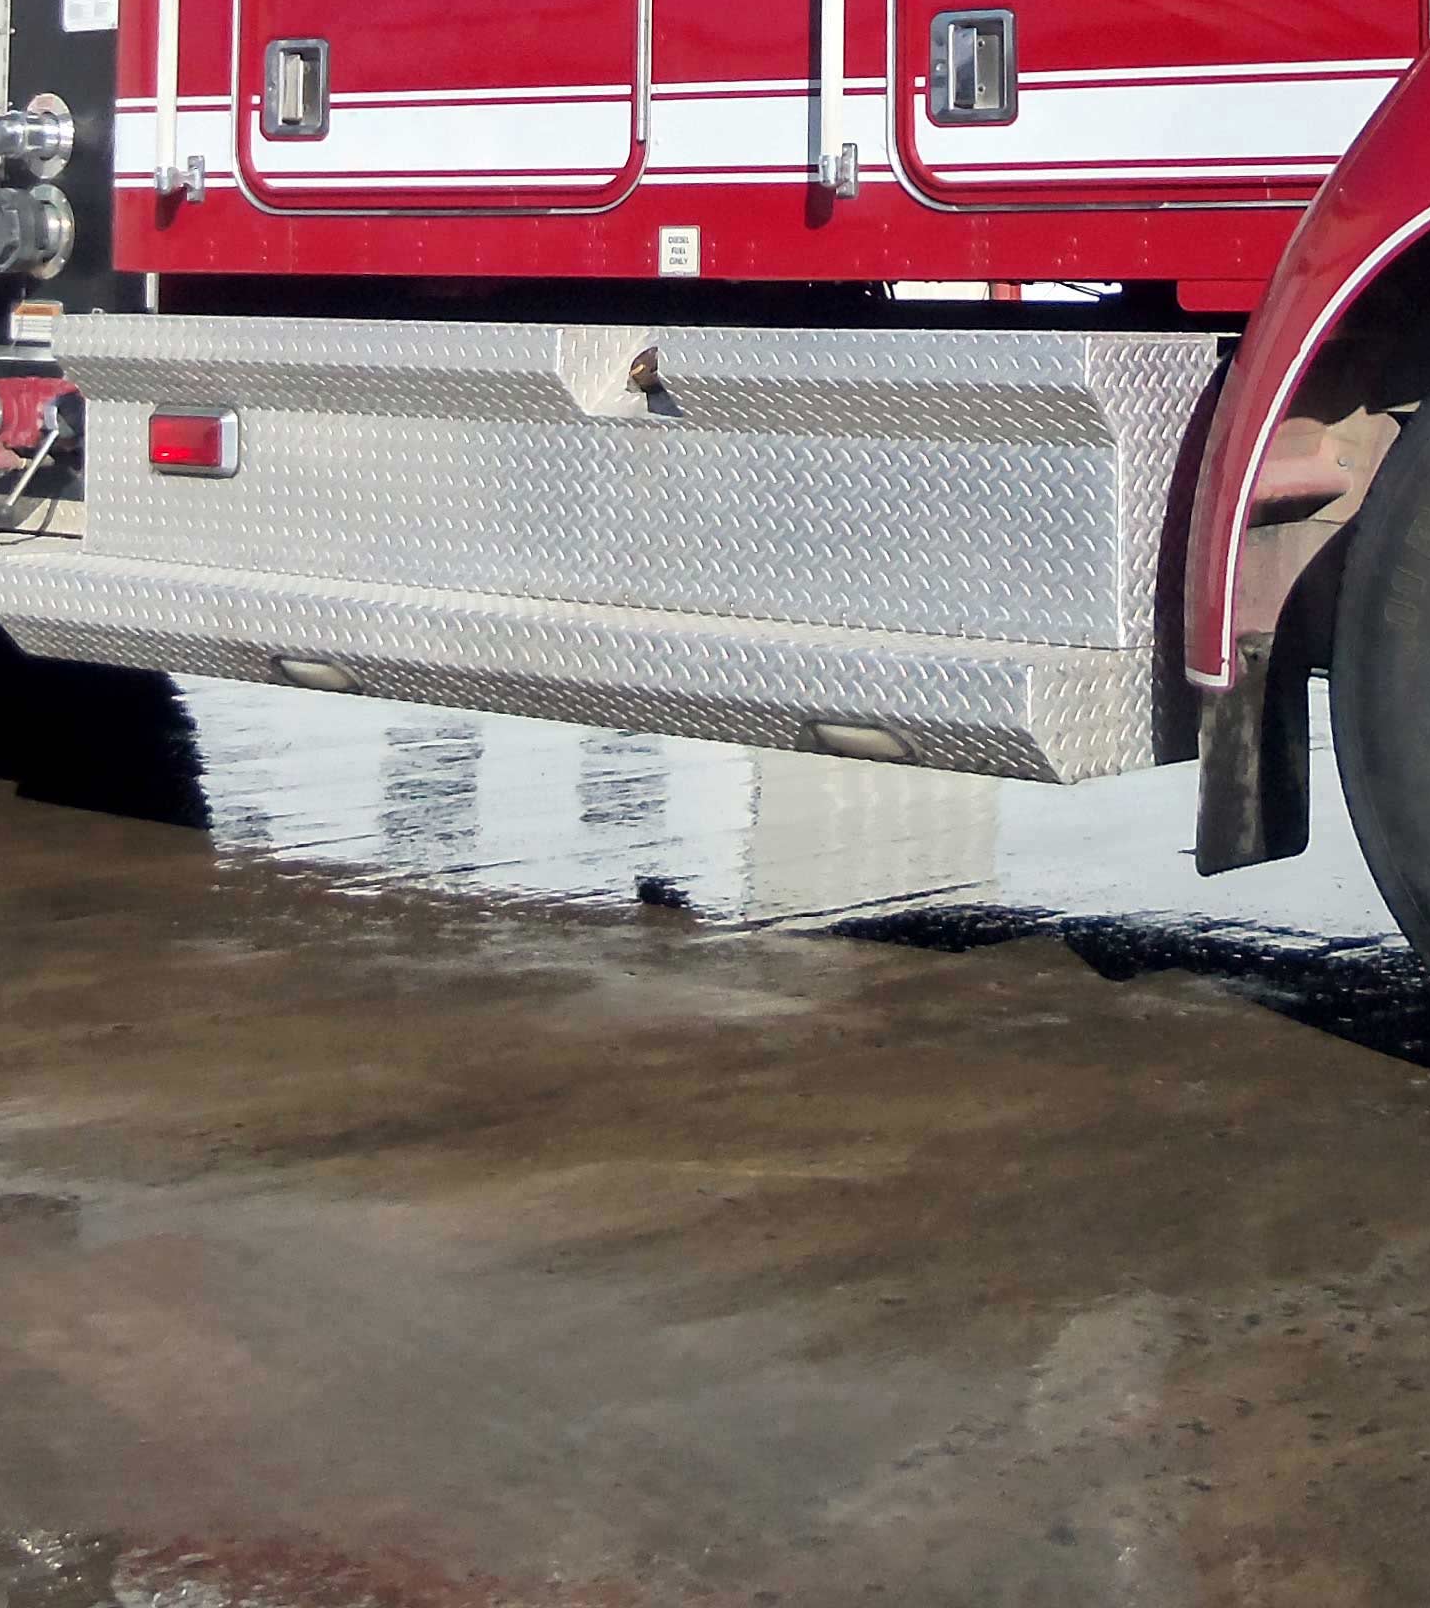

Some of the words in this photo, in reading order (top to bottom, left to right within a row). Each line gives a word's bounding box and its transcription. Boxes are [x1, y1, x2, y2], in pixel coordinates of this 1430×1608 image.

[667, 236, 690, 244] DIESEL
[671, 246, 686, 255] FUEL
[668, 257, 688, 265] ONLY
